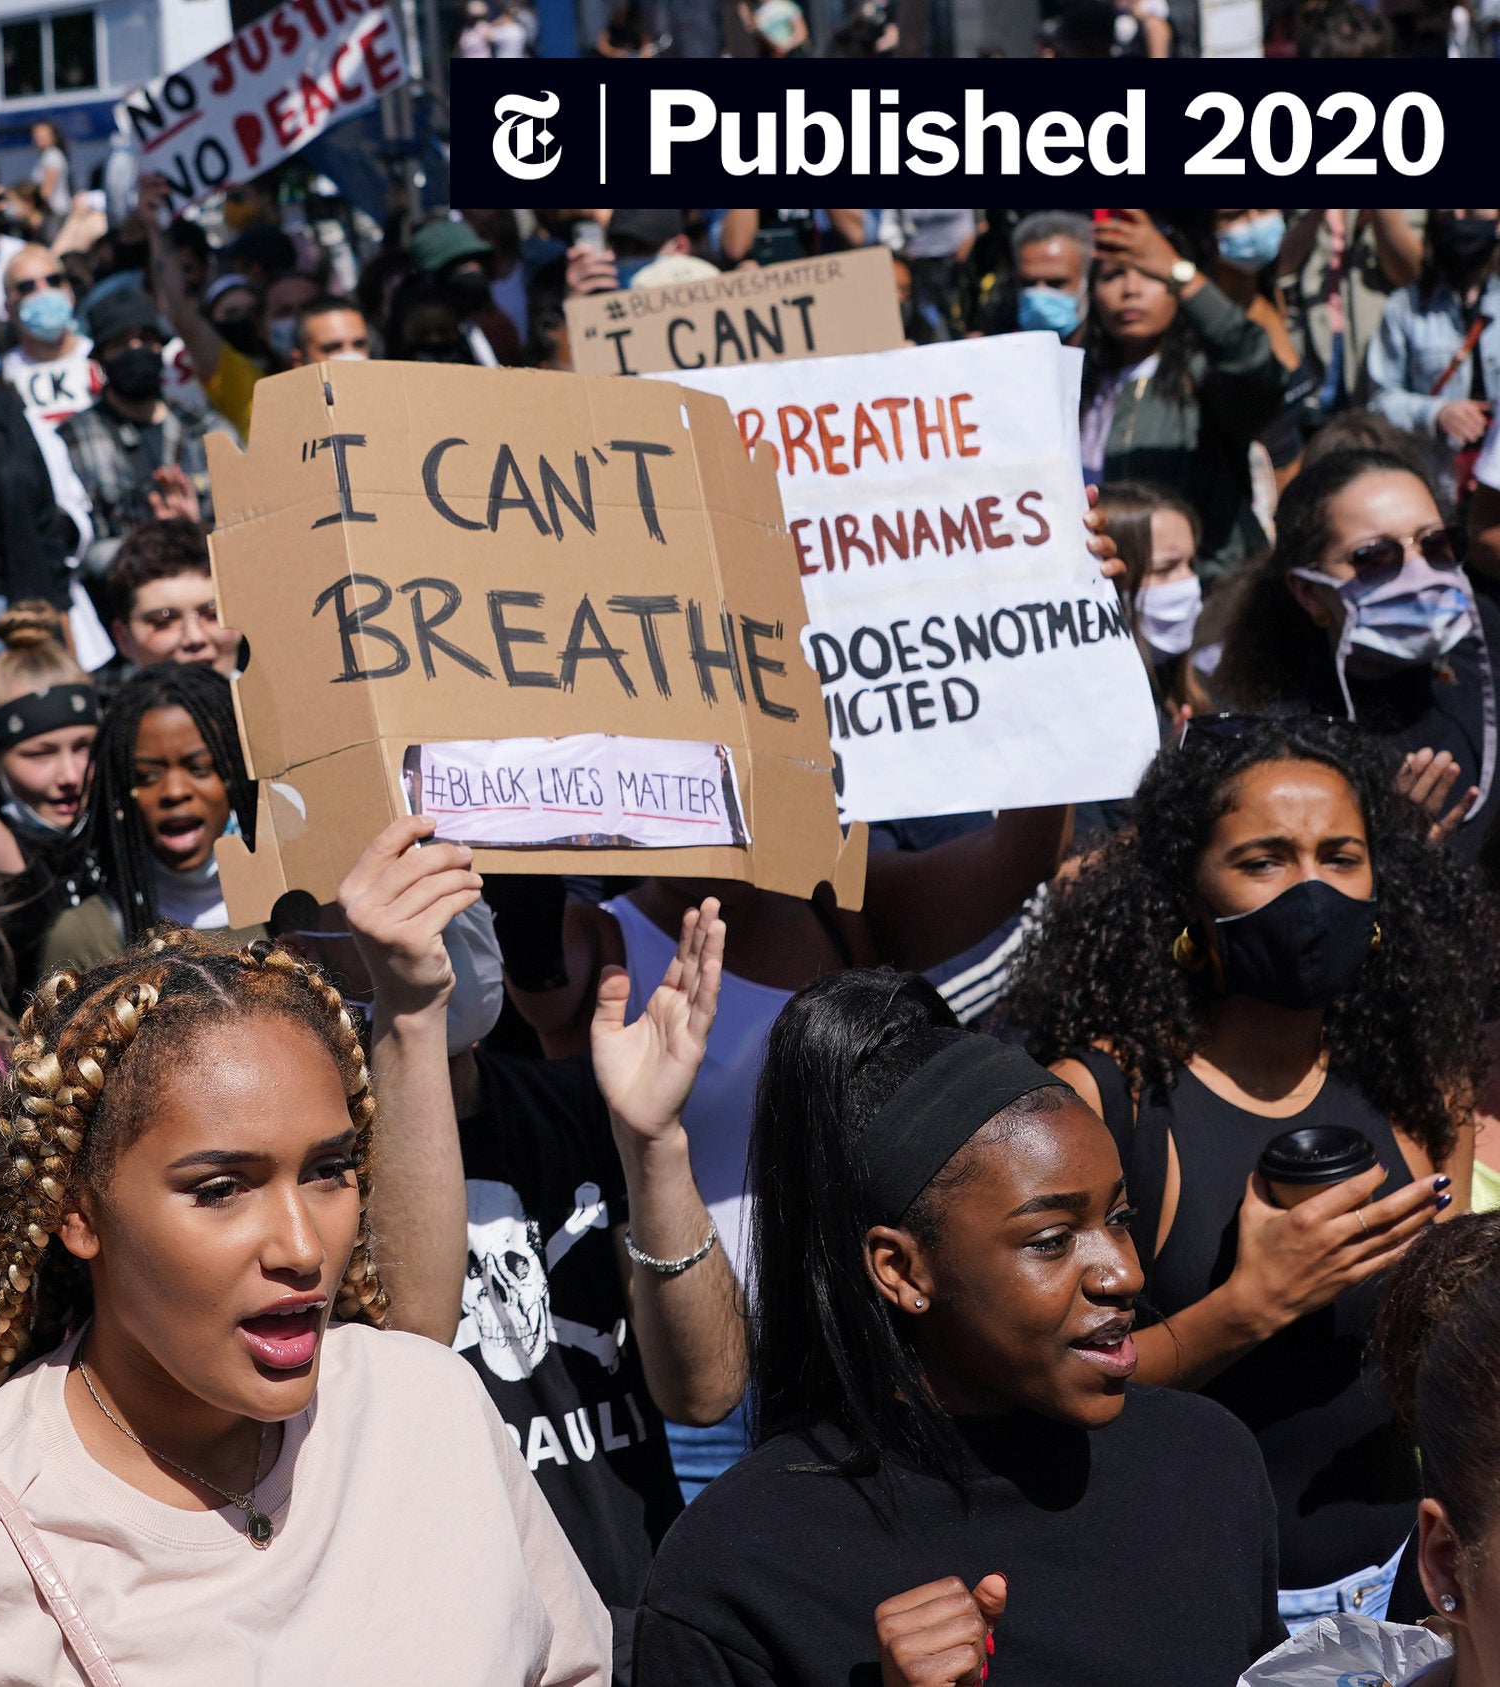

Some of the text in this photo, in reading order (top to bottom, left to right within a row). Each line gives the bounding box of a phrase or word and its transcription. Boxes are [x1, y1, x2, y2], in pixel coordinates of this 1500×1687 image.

[126, 0, 385, 142] NO JUSTI
[233, 20, 400, 168] PEACE
[668, 294, 816, 370] CAN'T
[421, 437, 675, 545] CAN'T
[311, 573, 800, 723] BREATHE"
[825, 677, 980, 739] ICTED
[424, 764, 721, 816] #BLACK LIVES MATTER
